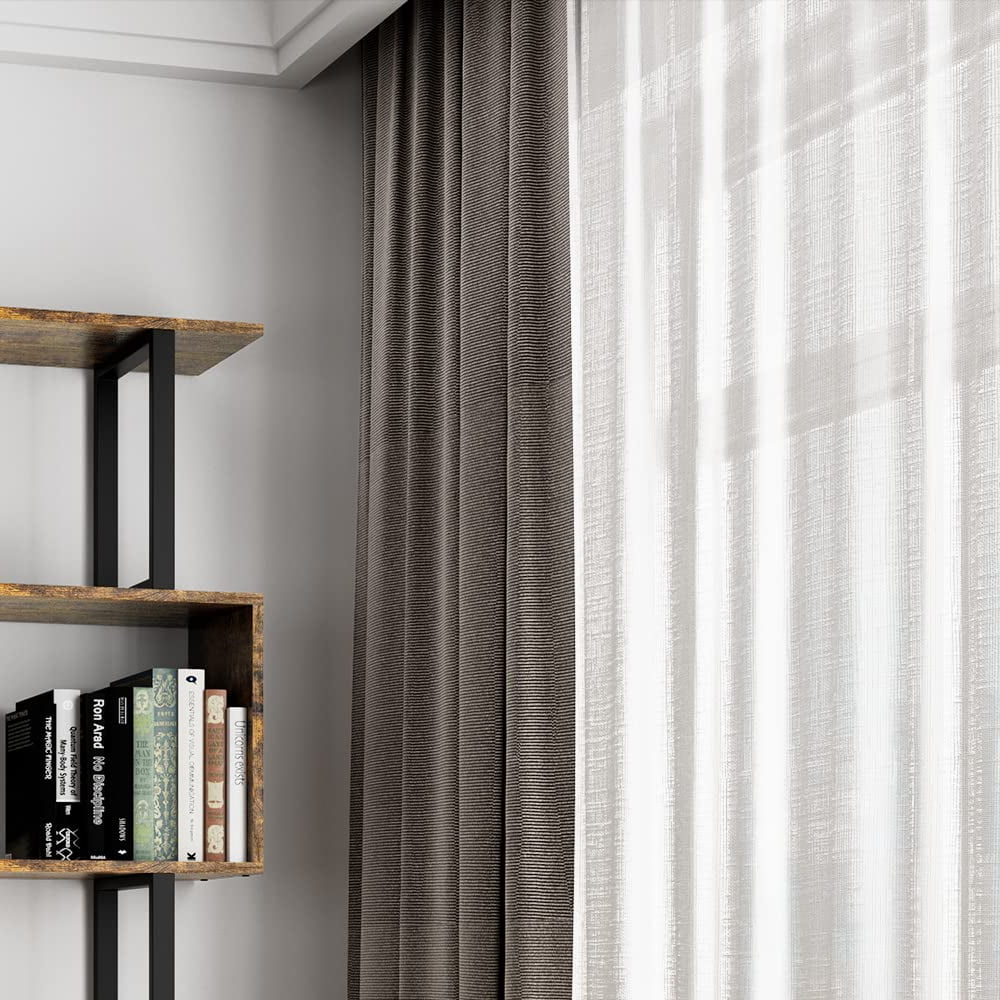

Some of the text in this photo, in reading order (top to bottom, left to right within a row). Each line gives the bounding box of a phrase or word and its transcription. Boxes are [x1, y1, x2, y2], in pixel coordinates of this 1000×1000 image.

[69, 726, 78, 752] Quantum
[93, 698, 105, 749] Ron Arad
[58, 740, 67, 796] Many-Body Systems
[69, 754, 78, 768] Field
[69, 769, 78, 788] Theory
[234, 720, 246, 786] Unicorns exists
[91, 756, 105, 826] No Discipline
